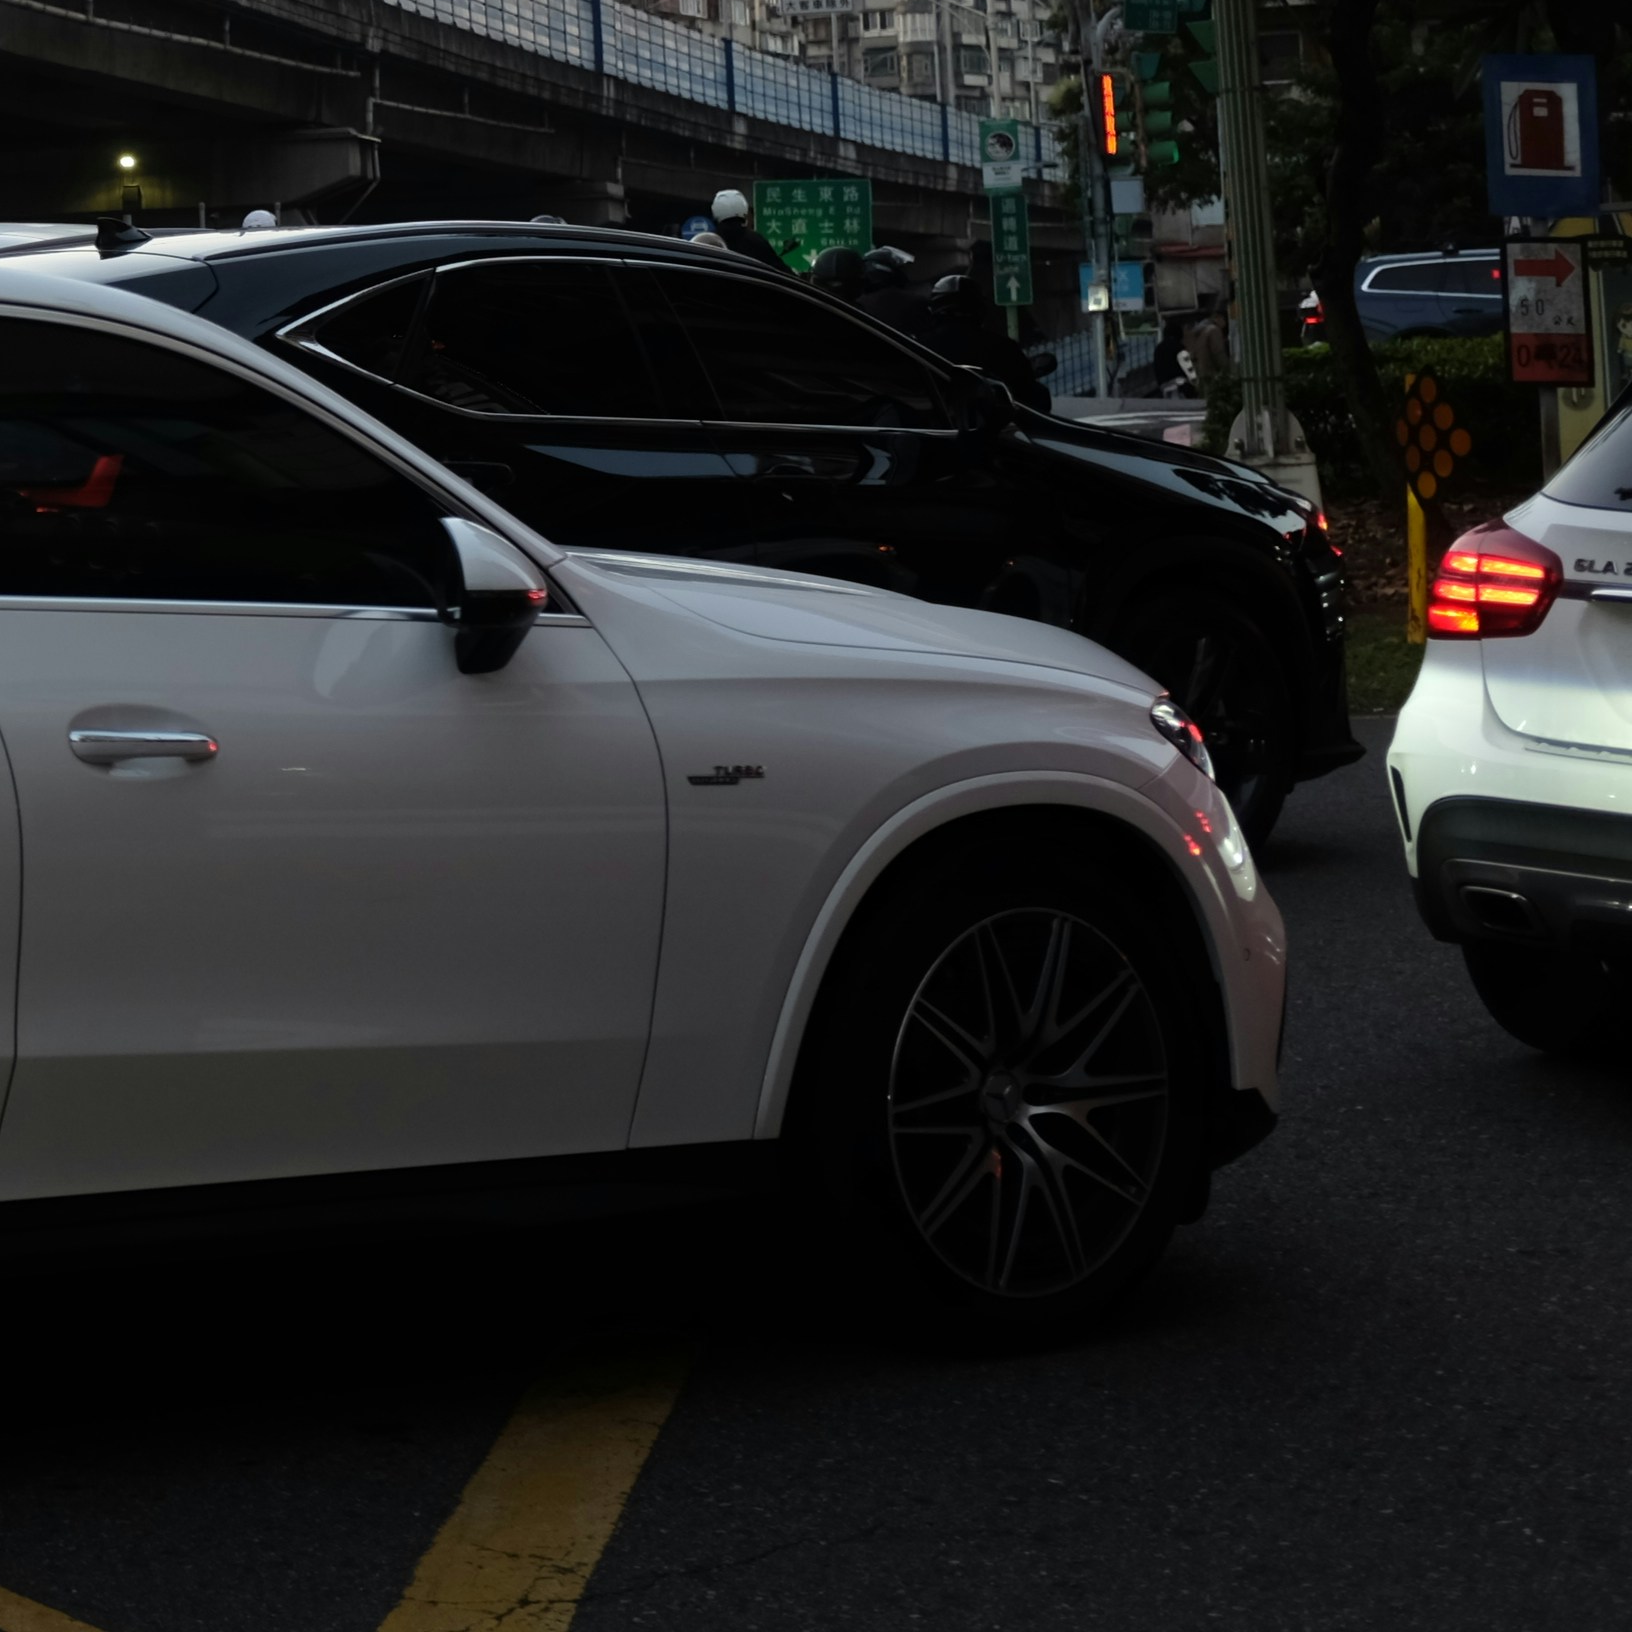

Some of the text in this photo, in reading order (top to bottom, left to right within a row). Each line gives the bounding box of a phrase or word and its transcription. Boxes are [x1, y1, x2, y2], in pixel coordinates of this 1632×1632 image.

[766, 185, 859, 203] 民生東路
[1520, 298, 1544, 316] 50
[1574, 558, 1618, 575] GLA
